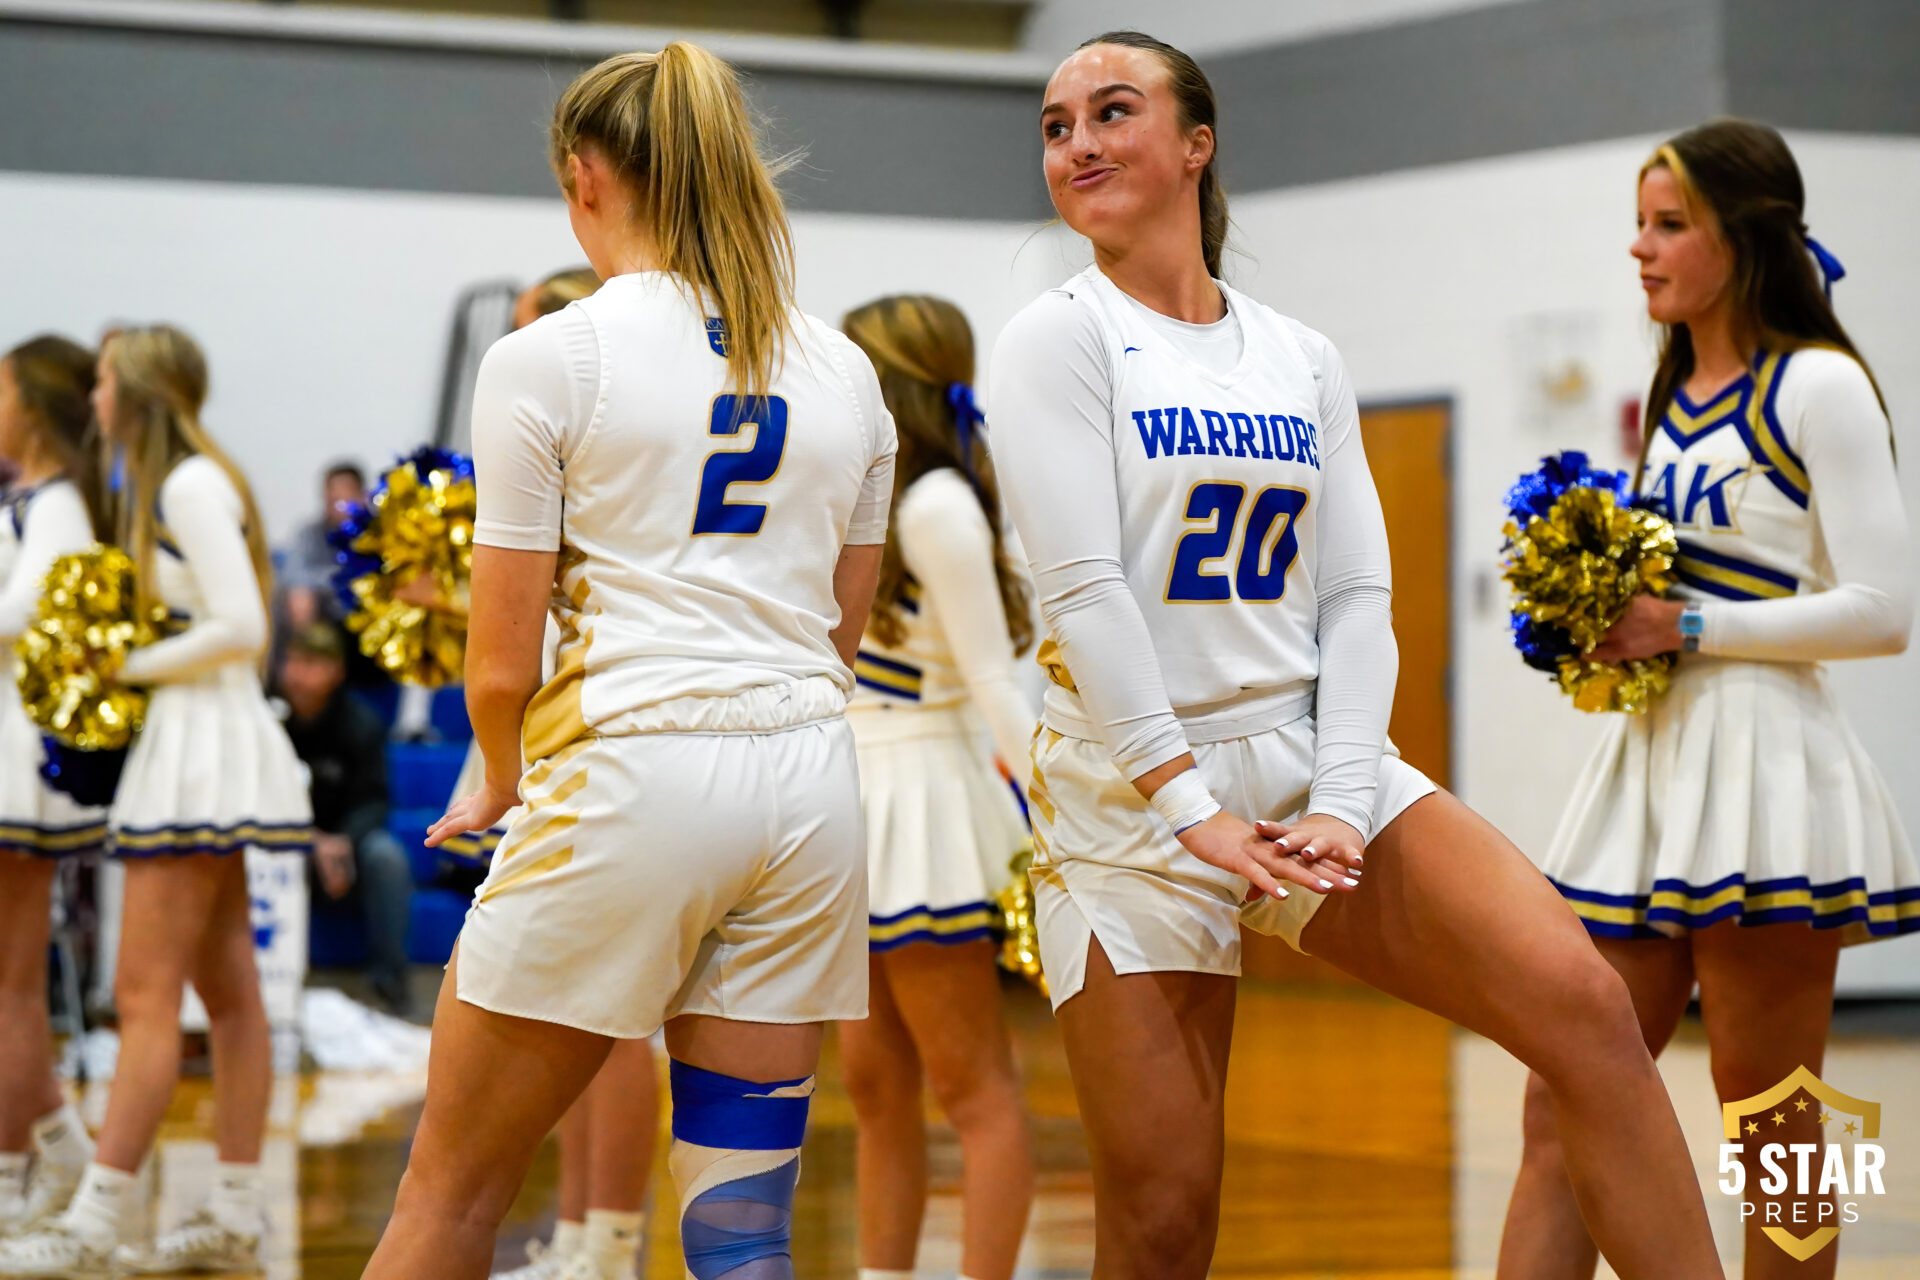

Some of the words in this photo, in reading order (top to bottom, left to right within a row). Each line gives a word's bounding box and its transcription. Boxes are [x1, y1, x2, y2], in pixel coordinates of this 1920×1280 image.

[690, 392, 790, 538] 2
[1132, 407, 1320, 471] WARRIORS
[1163, 479, 1311, 604] 20
[1643, 457, 1764, 535] AK
